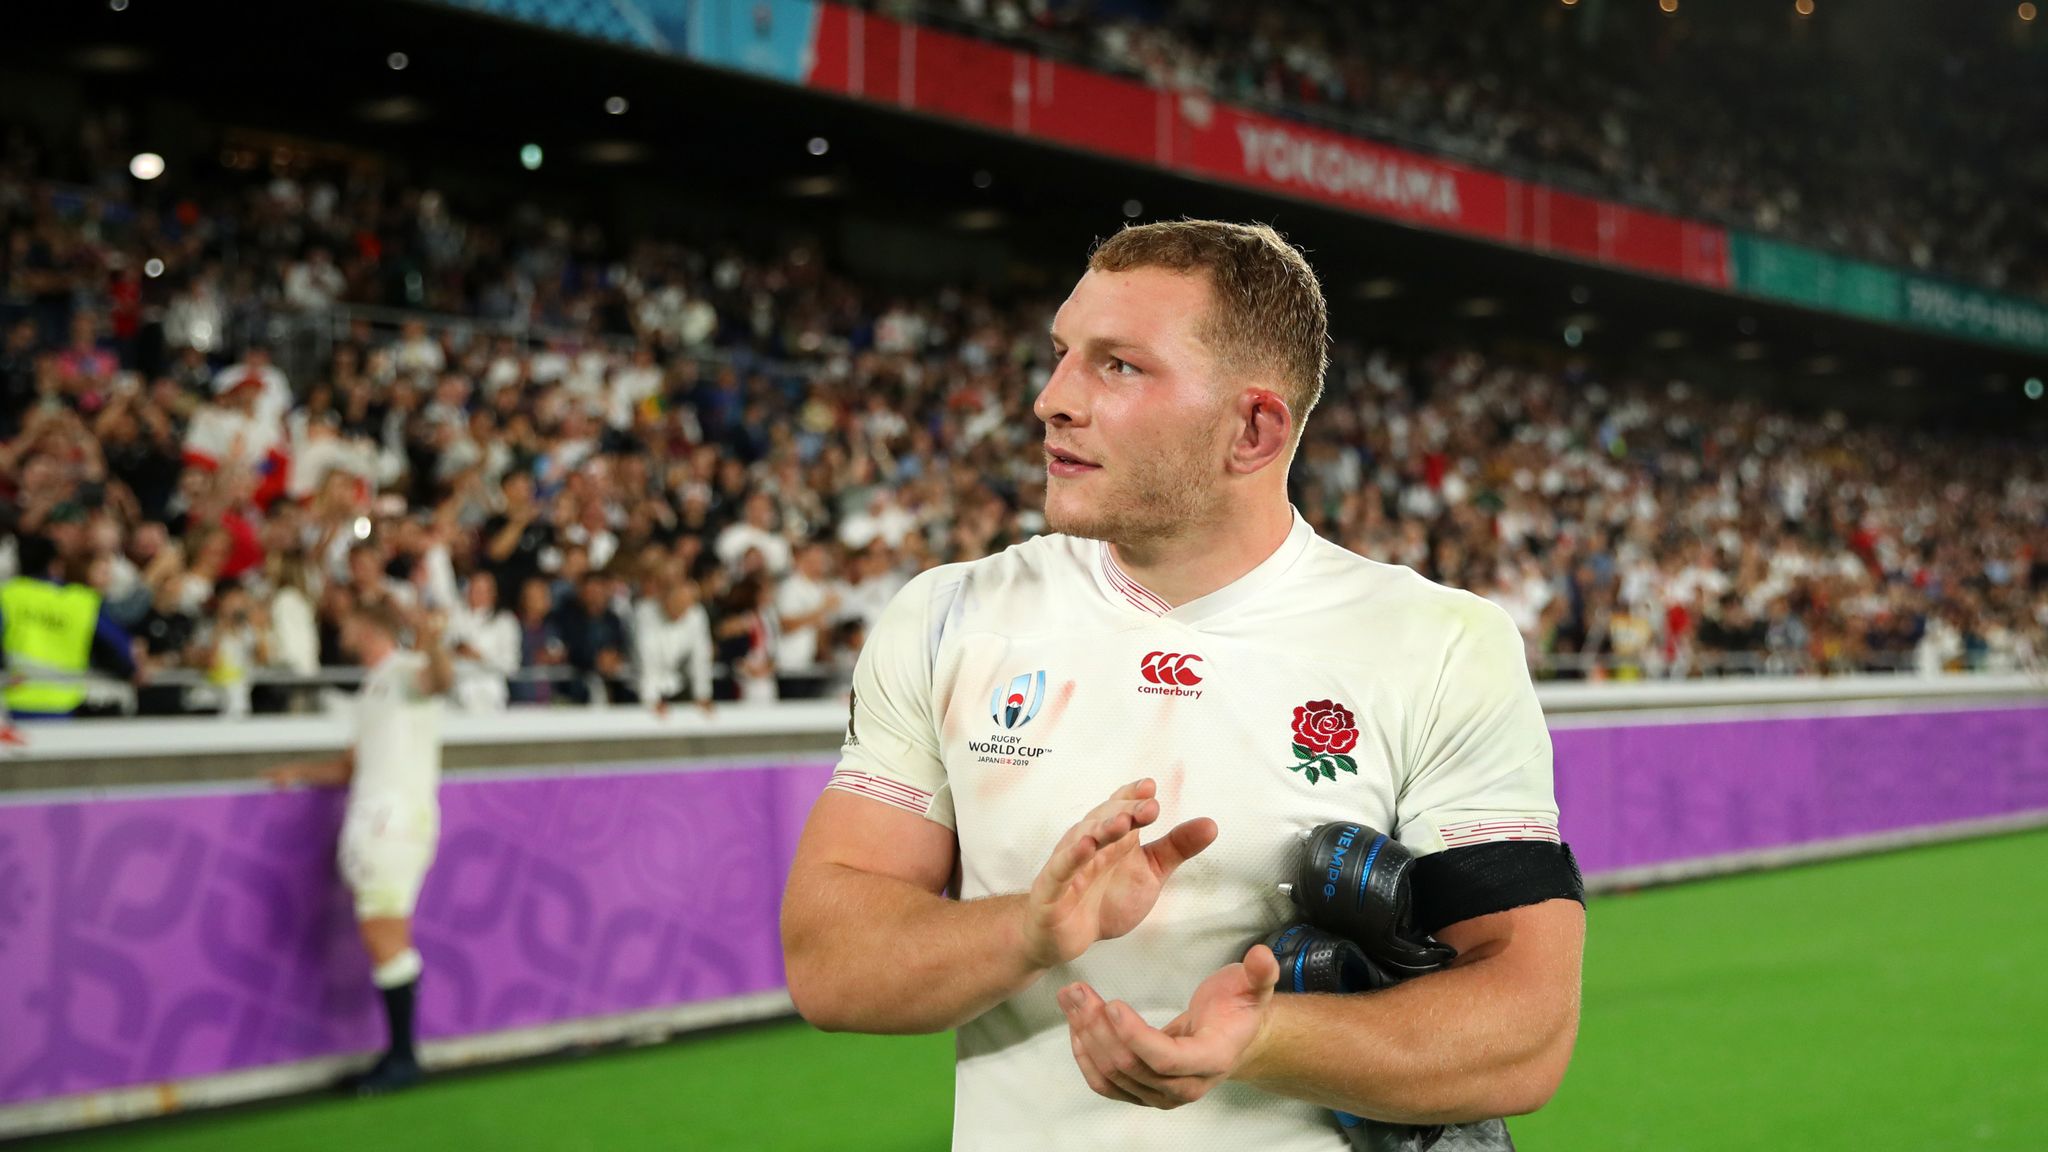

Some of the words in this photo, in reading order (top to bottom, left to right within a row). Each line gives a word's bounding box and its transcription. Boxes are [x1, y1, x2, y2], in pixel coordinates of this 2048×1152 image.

[1236, 121, 1462, 218] YOKOHAMA
[1137, 686, 1203, 700] canterbury
[991, 735, 1021, 744] RUGBY
[968, 741, 1015, 755] WORLD
[1323, 825, 1360, 897] TIEMPO
